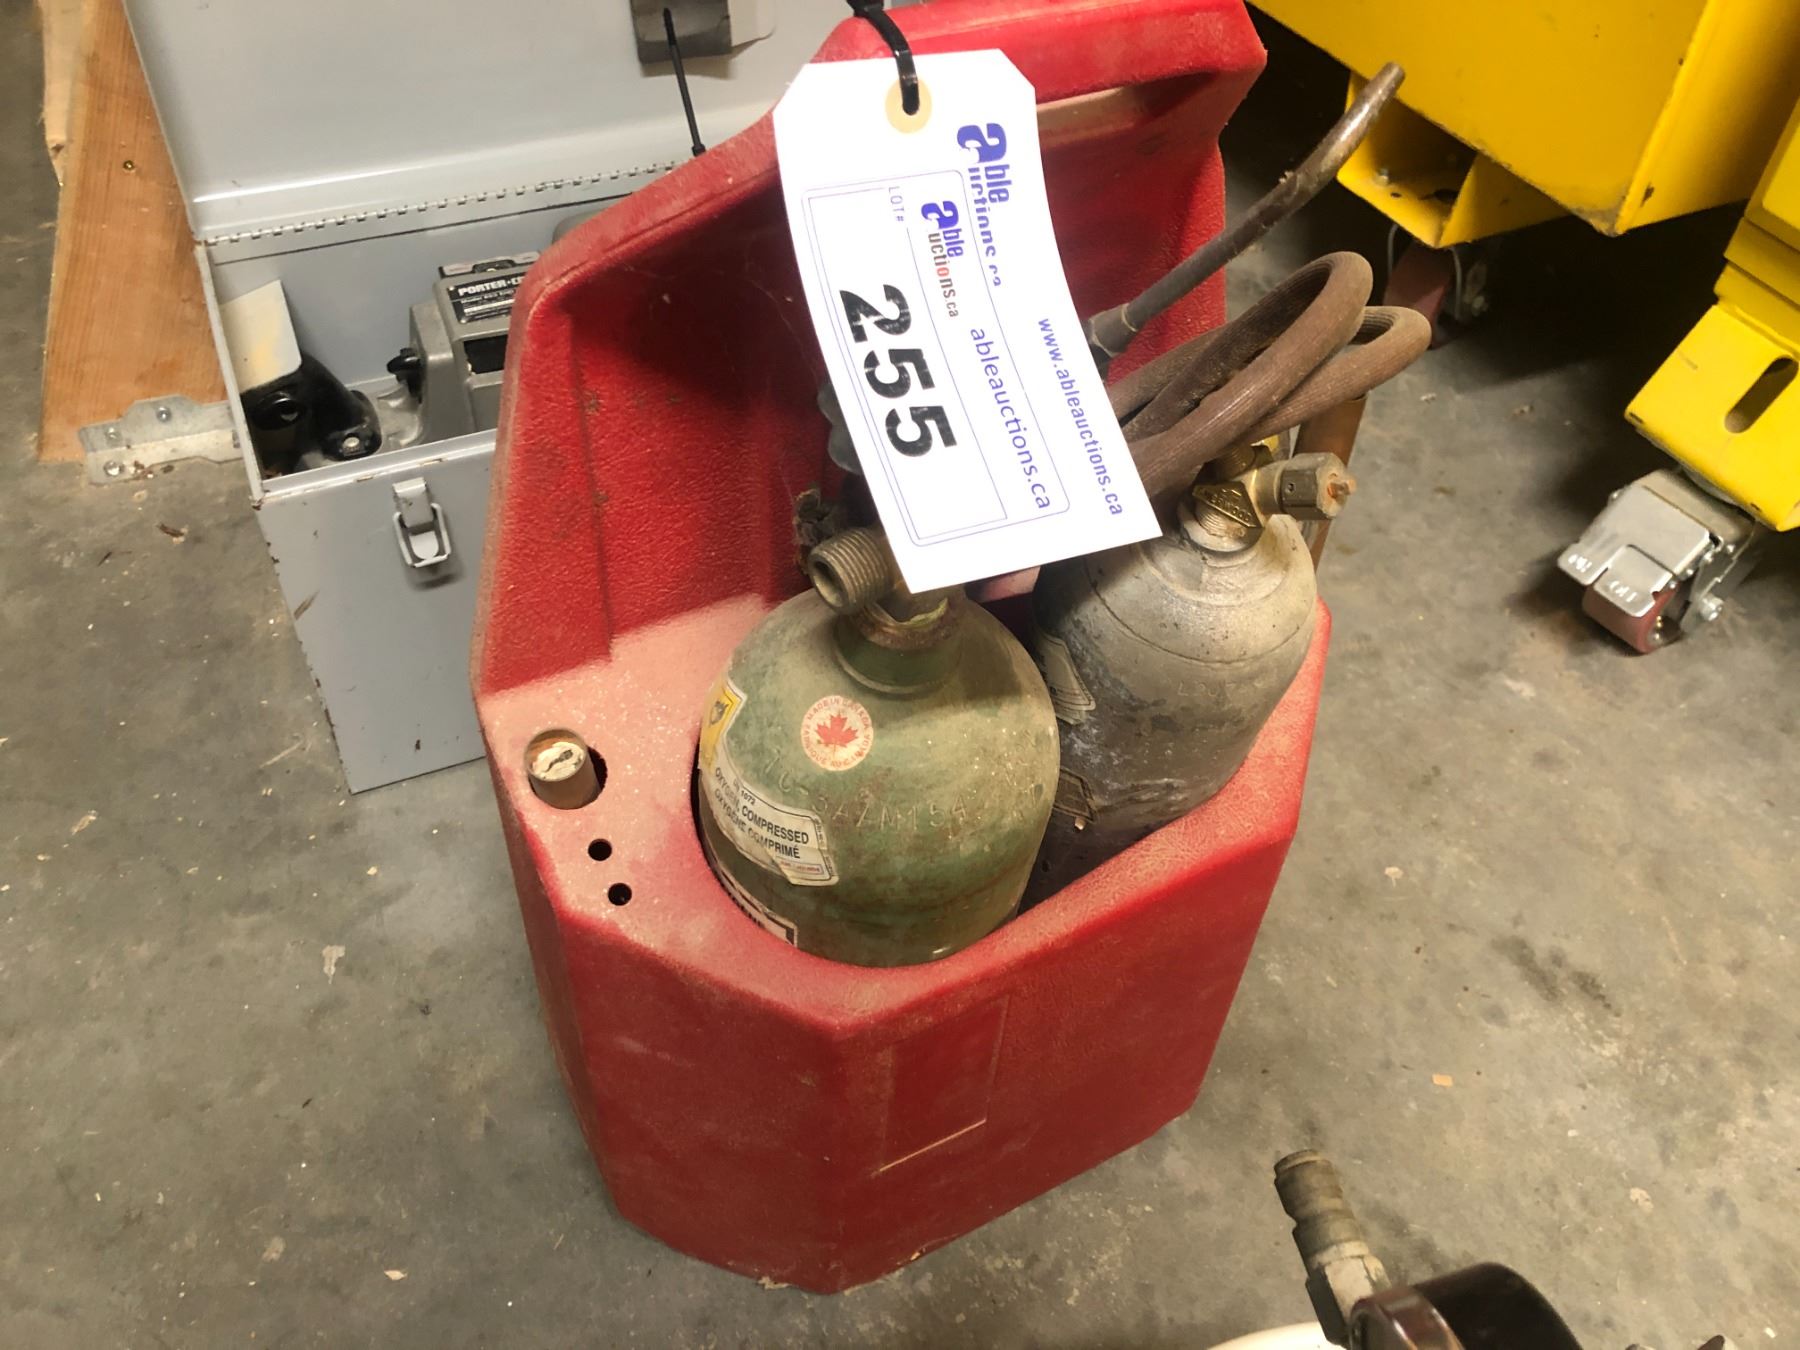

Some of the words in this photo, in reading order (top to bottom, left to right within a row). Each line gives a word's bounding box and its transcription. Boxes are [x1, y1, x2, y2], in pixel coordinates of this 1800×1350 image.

[920, 199, 966, 259] able
[838, 282, 959, 458] 255
[970, 326, 1052, 510] ableauctions.ca
[1037, 317, 1124, 517] www.ableauctions.ca
[741, 804, 810, 846] COMPRESSED
